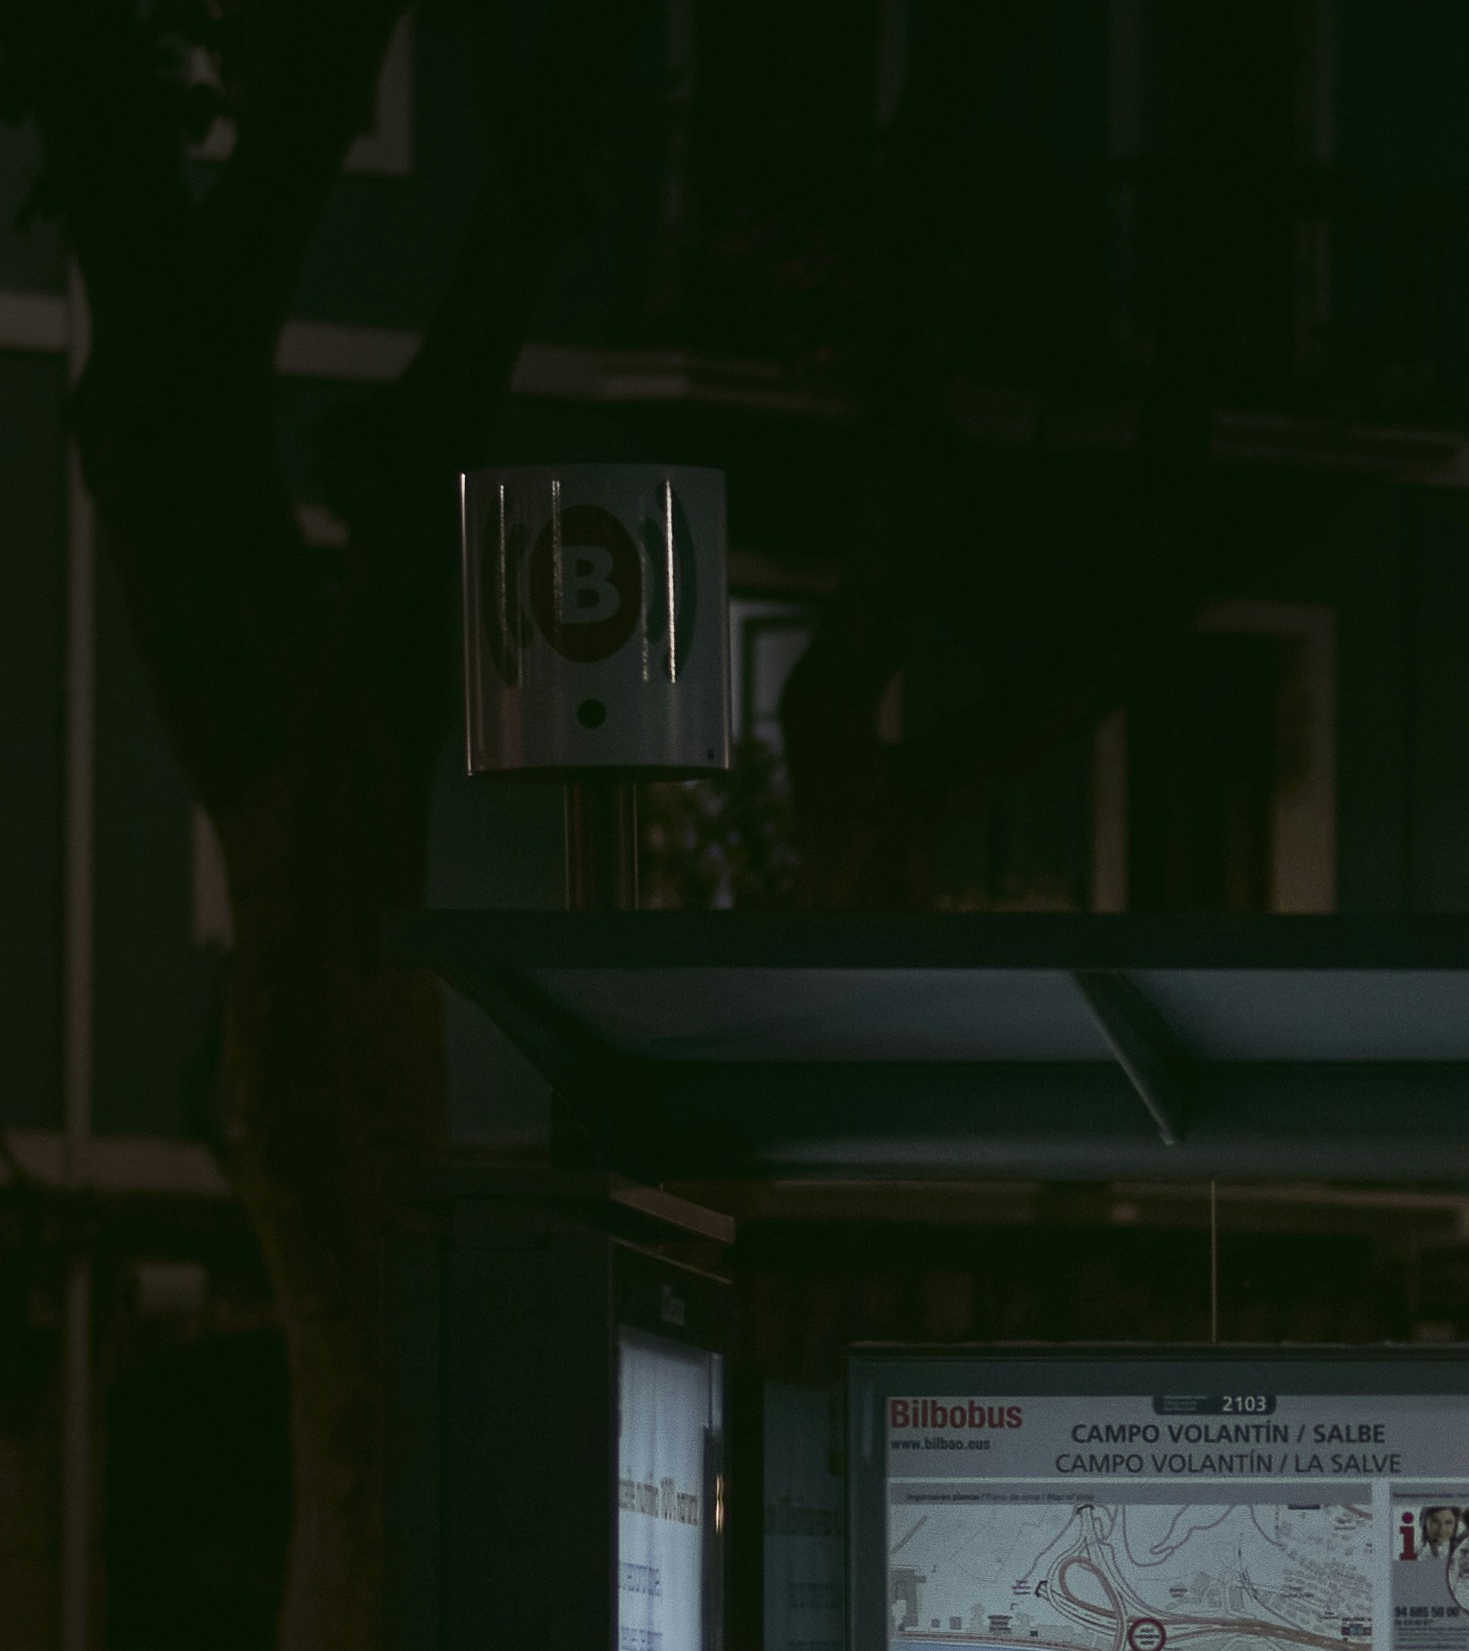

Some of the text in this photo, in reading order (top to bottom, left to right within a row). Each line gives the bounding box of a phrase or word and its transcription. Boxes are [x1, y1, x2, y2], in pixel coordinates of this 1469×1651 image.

[560, 545, 621, 625] B
[890, 1400, 1022, 1428] Bilbobus
[1222, 1396, 1267, 1412] 2103
[890, 1437, 991, 1451] www.bilbao.eus
[1071, 1424, 1159, 1444] CAMPO
[1167, 1420, 1289, 1444] VOLANTÍN
[1313, 1424, 1386, 1444] SALBE
[1055, 1453, 1144, 1474] CAMPO
[1152, 1449, 1272, 1474] VOLANTÍN
[1294, 1453, 1325, 1474] LA
[1331, 1453, 1403, 1474] SALVE
